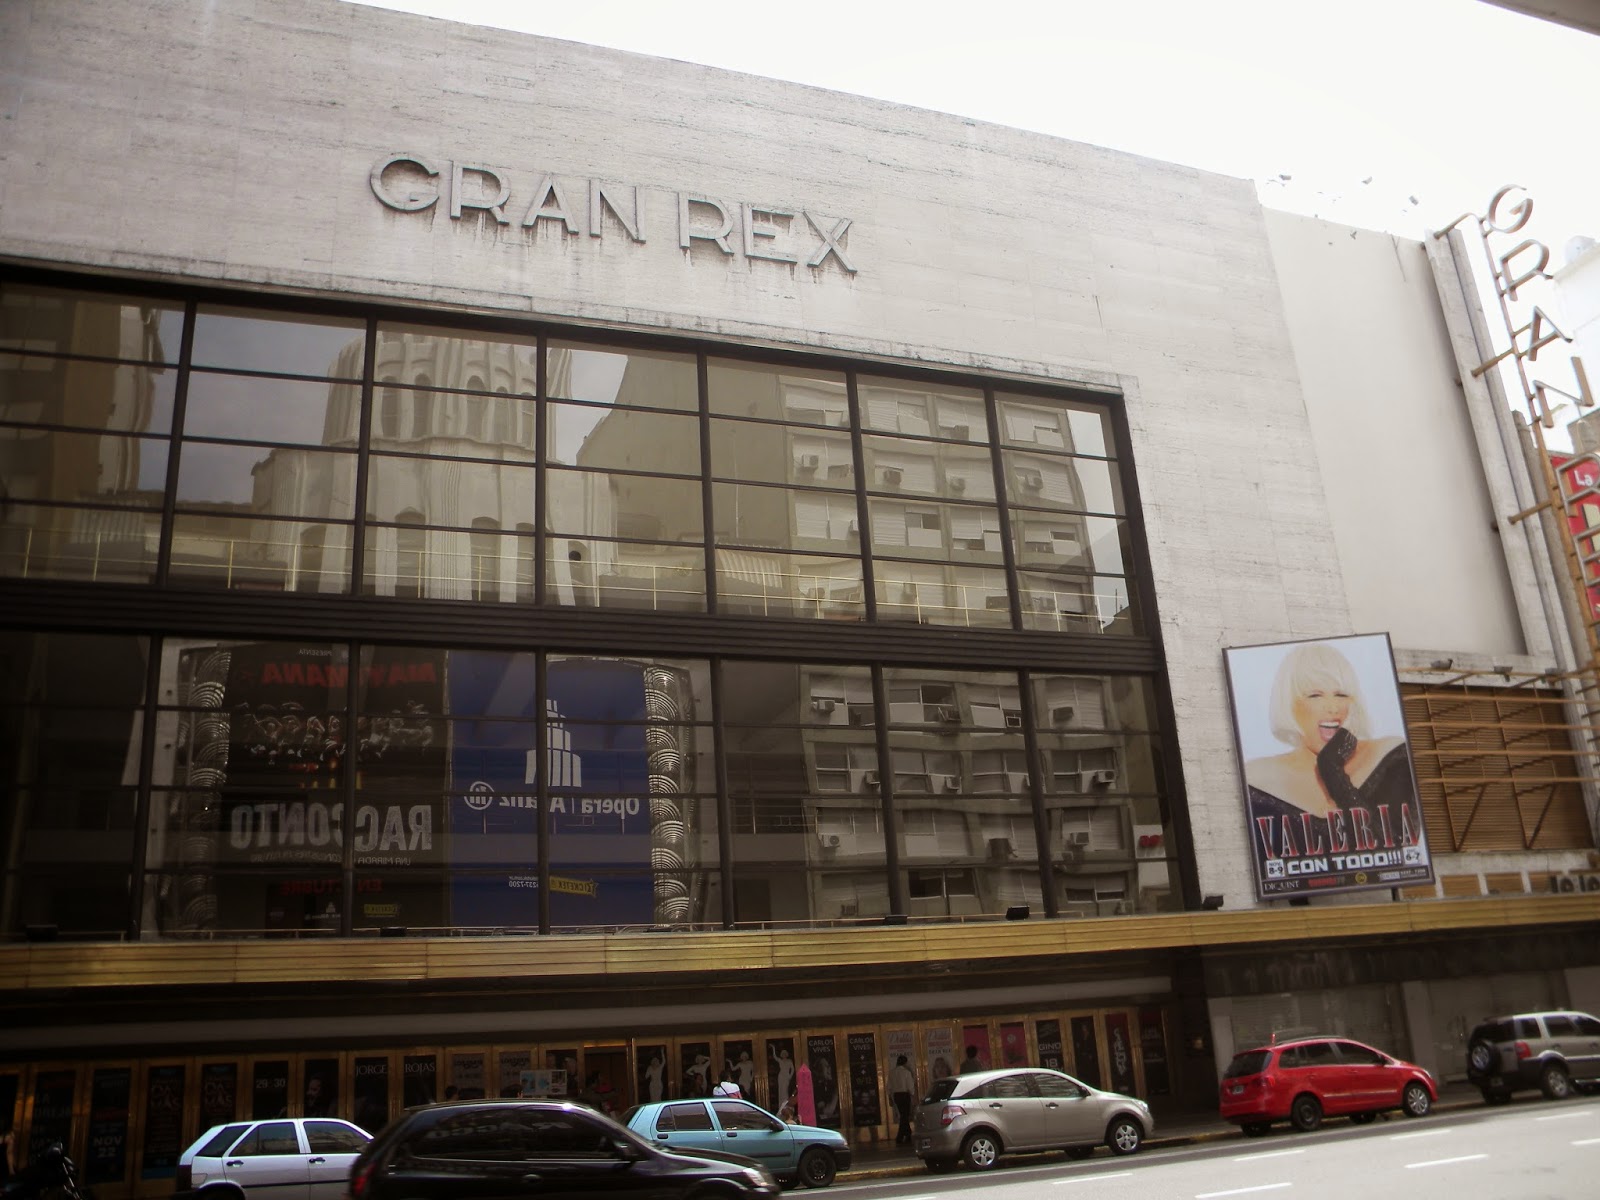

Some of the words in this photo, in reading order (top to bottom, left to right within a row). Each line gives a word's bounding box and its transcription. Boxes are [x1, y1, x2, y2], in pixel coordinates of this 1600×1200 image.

[369, 153, 646, 244] GRAN
[677, 191, 857, 274] REX
[1488, 184, 1594, 428] GRAN
[1255, 802, 1421, 860] VALERIA
[1287, 857, 1329, 875] CON
[1331, 850, 1402, 871] TODO!!!
[808, 1038, 834, 1047] CARLOS
[812, 1045, 831, 1053] VIVES
[849, 1036, 874, 1045] CARLOS
[355, 1064, 387, 1077] JORGE
[404, 1062, 436, 1076] ROJAS
